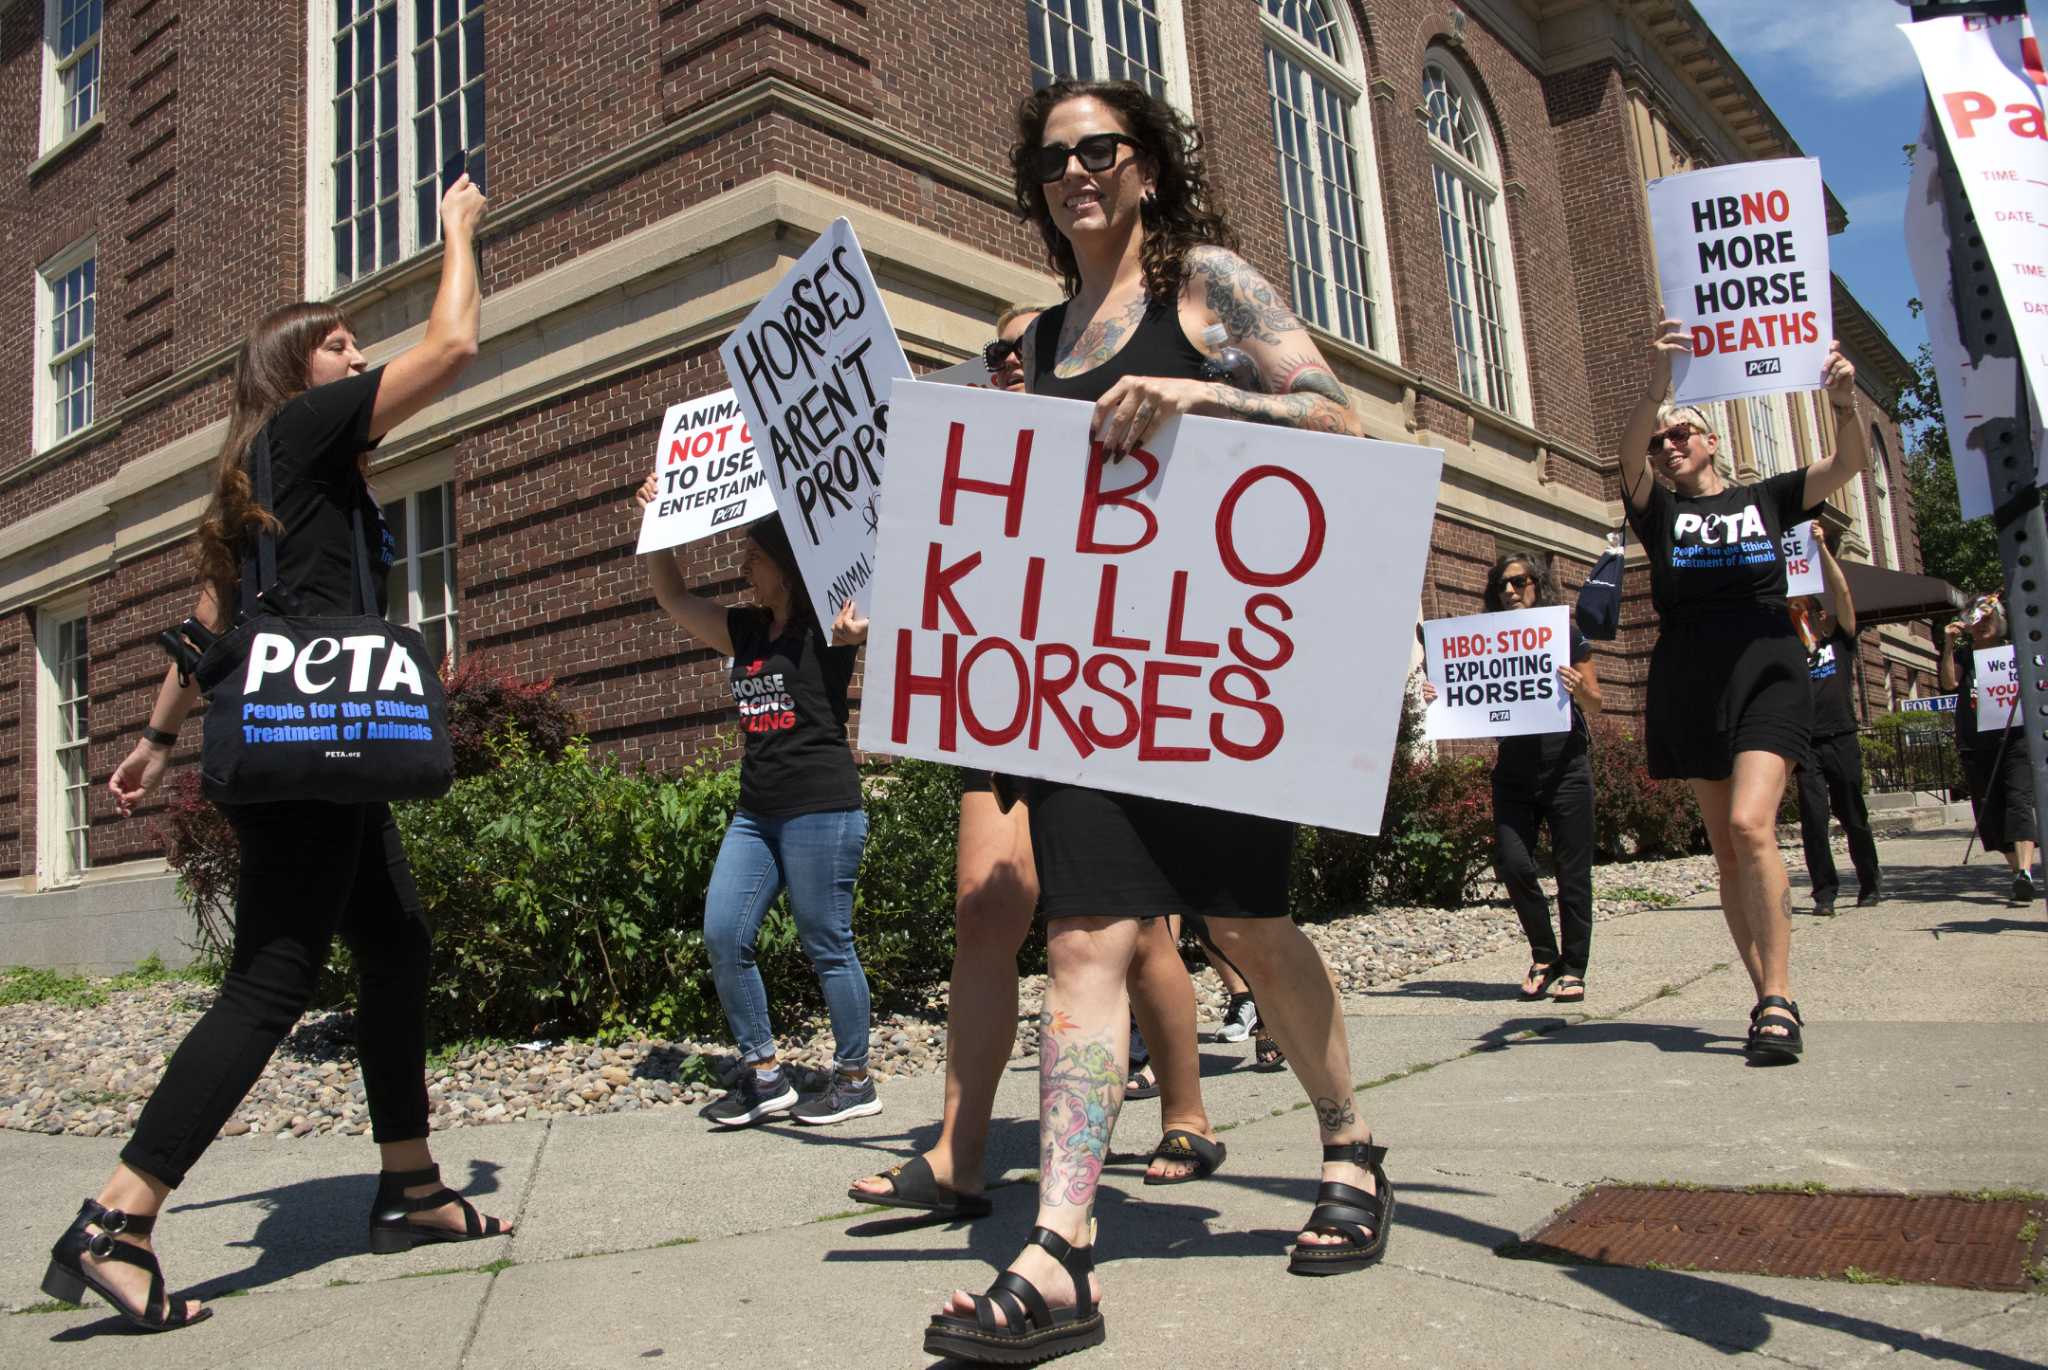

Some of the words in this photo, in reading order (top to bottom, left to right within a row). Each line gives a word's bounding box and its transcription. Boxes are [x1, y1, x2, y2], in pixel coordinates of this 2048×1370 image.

[1981, 170, 2018, 182] TIME
[1692, 189, 1790, 233] HBNO
[1995, 211, 2034, 223] DATE
[1698, 231, 1796, 274] MORE
[2013, 263, 2047, 278] TIME
[1694, 271, 1808, 316] HORSE
[733, 245, 865, 426] HORSES
[1690, 311, 1819, 358] DEATHS
[769, 337, 876, 490] AREN'T
[668, 424, 733, 465] NOT
[665, 465, 698, 495] TO
[707, 446, 755, 482] USE
[939, 422, 1327, 587] HBO
[1672, 557, 1724, 569] Treatment
[1738, 551, 1776, 566] Animals
[1673, 545, 1703, 557] People
[1742, 539, 1773, 552] Ethical
[827, 552, 874, 615] ANIMAL
[921, 542, 1295, 671] KILLS
[1442, 633, 1492, 659] HBO:
[1497, 626, 1552, 653] STOP
[1445, 653, 1552, 684] EXPLOITING
[1987, 660, 2006, 672] We
[731, 673, 785, 699] HORSE
[891, 629, 1285, 762] HORSES
[1446, 677, 1553, 707] HORSES
[242, 703, 305, 721] People
[309, 702, 337, 719] for
[341, 701, 371, 718] the
[375, 700, 429, 720] Ethical
[739, 692, 795, 717] ACING
[1905, 701, 1932, 712] FOR
[242, 724, 338, 743] Treatment
[343, 722, 362, 741] of
[367, 721, 433, 741] Animals
